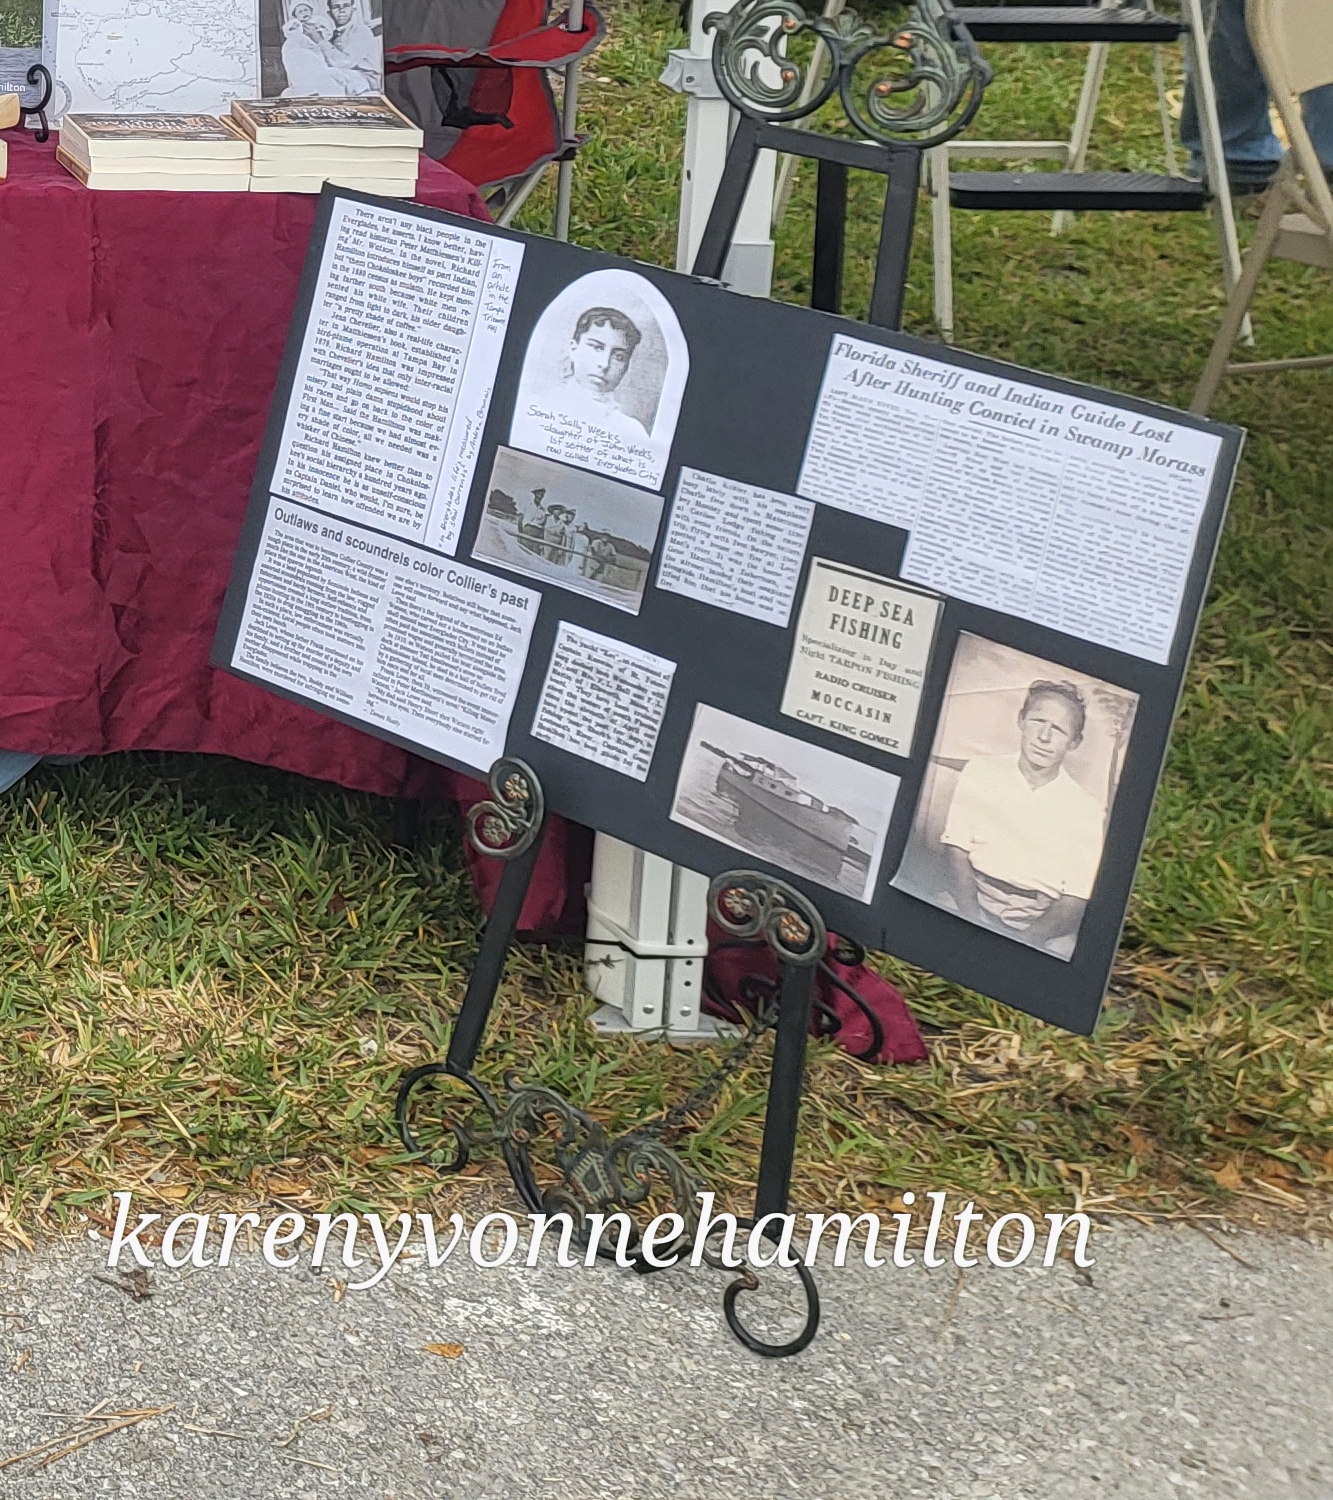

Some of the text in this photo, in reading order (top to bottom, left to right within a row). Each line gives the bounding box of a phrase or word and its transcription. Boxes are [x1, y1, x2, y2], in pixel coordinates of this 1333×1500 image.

[833, 342, 1175, 444] Florida Sheriff and Indian Guide Lost
[843, 367, 1207, 477] After Hunting Convict in Swamp Morass
[274, 508, 529, 610] Outlaws and scoundrels color Collier's past
[827, 585, 914, 626] DEEP SEA
[829, 613, 903, 649] FISHING
[811, 690, 892, 724] MOCCASIN
